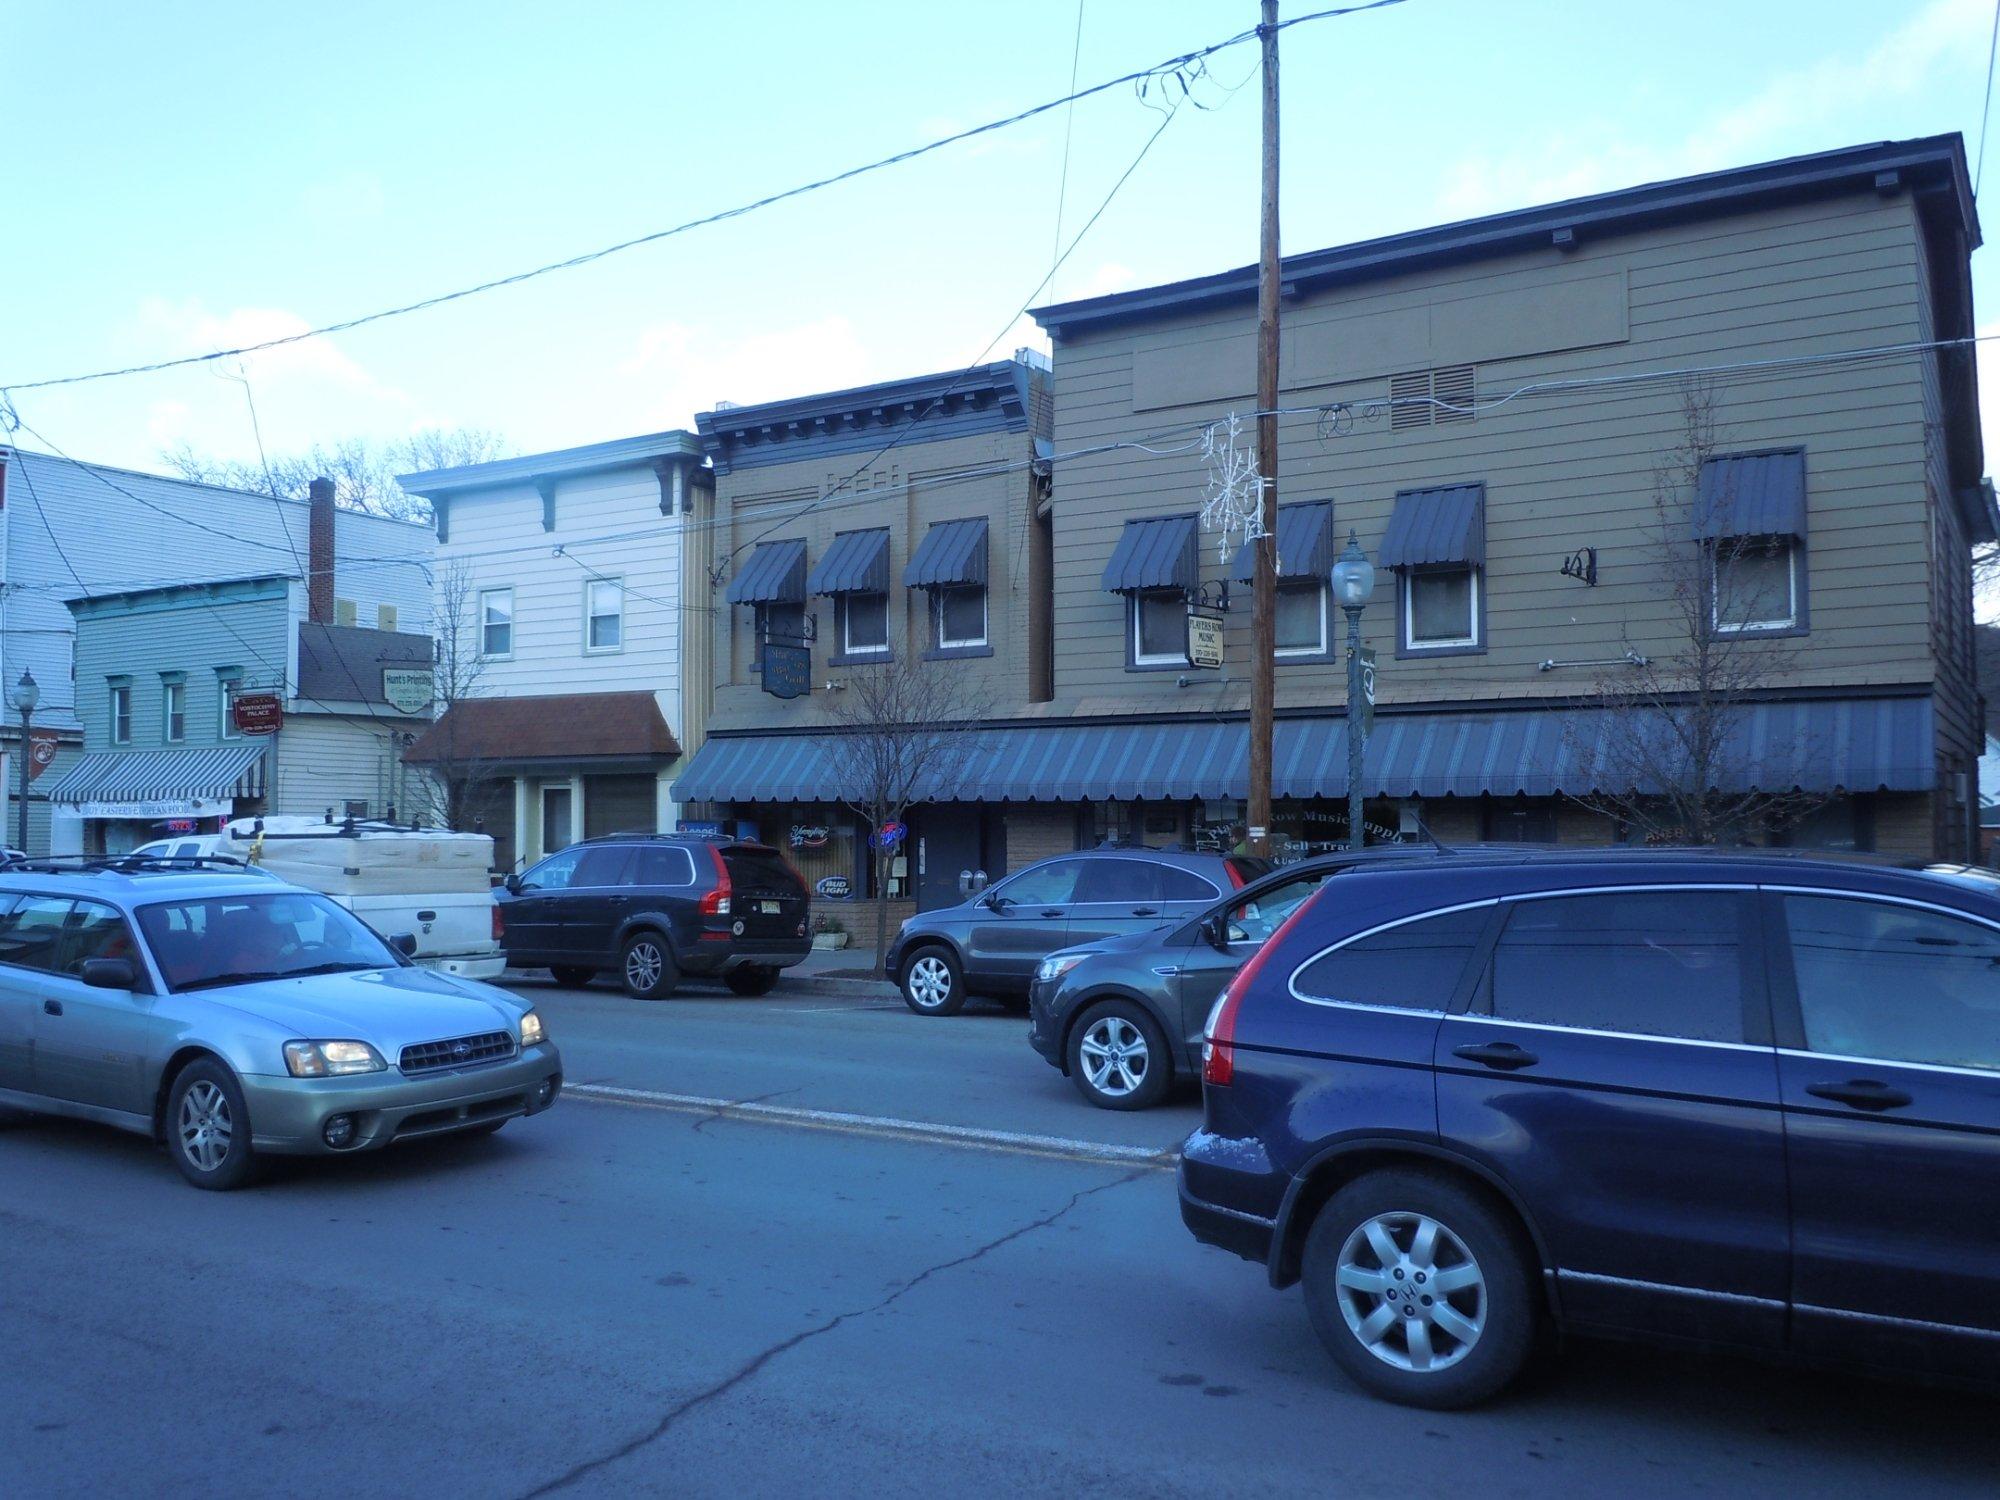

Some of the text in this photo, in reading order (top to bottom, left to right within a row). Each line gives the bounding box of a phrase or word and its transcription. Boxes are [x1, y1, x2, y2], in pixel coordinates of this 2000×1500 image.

[1198, 631, 1215, 643] MUSIC
[386, 674, 432, 687] Hunt's Printing
[1302, 811, 1350, 825] Music
[1364, 821, 1407, 845] upply
[1283, 841, 1309, 851] Sell
[825, 880, 847, 888] BUD
[820, 887, 850, 895] LIGHT
